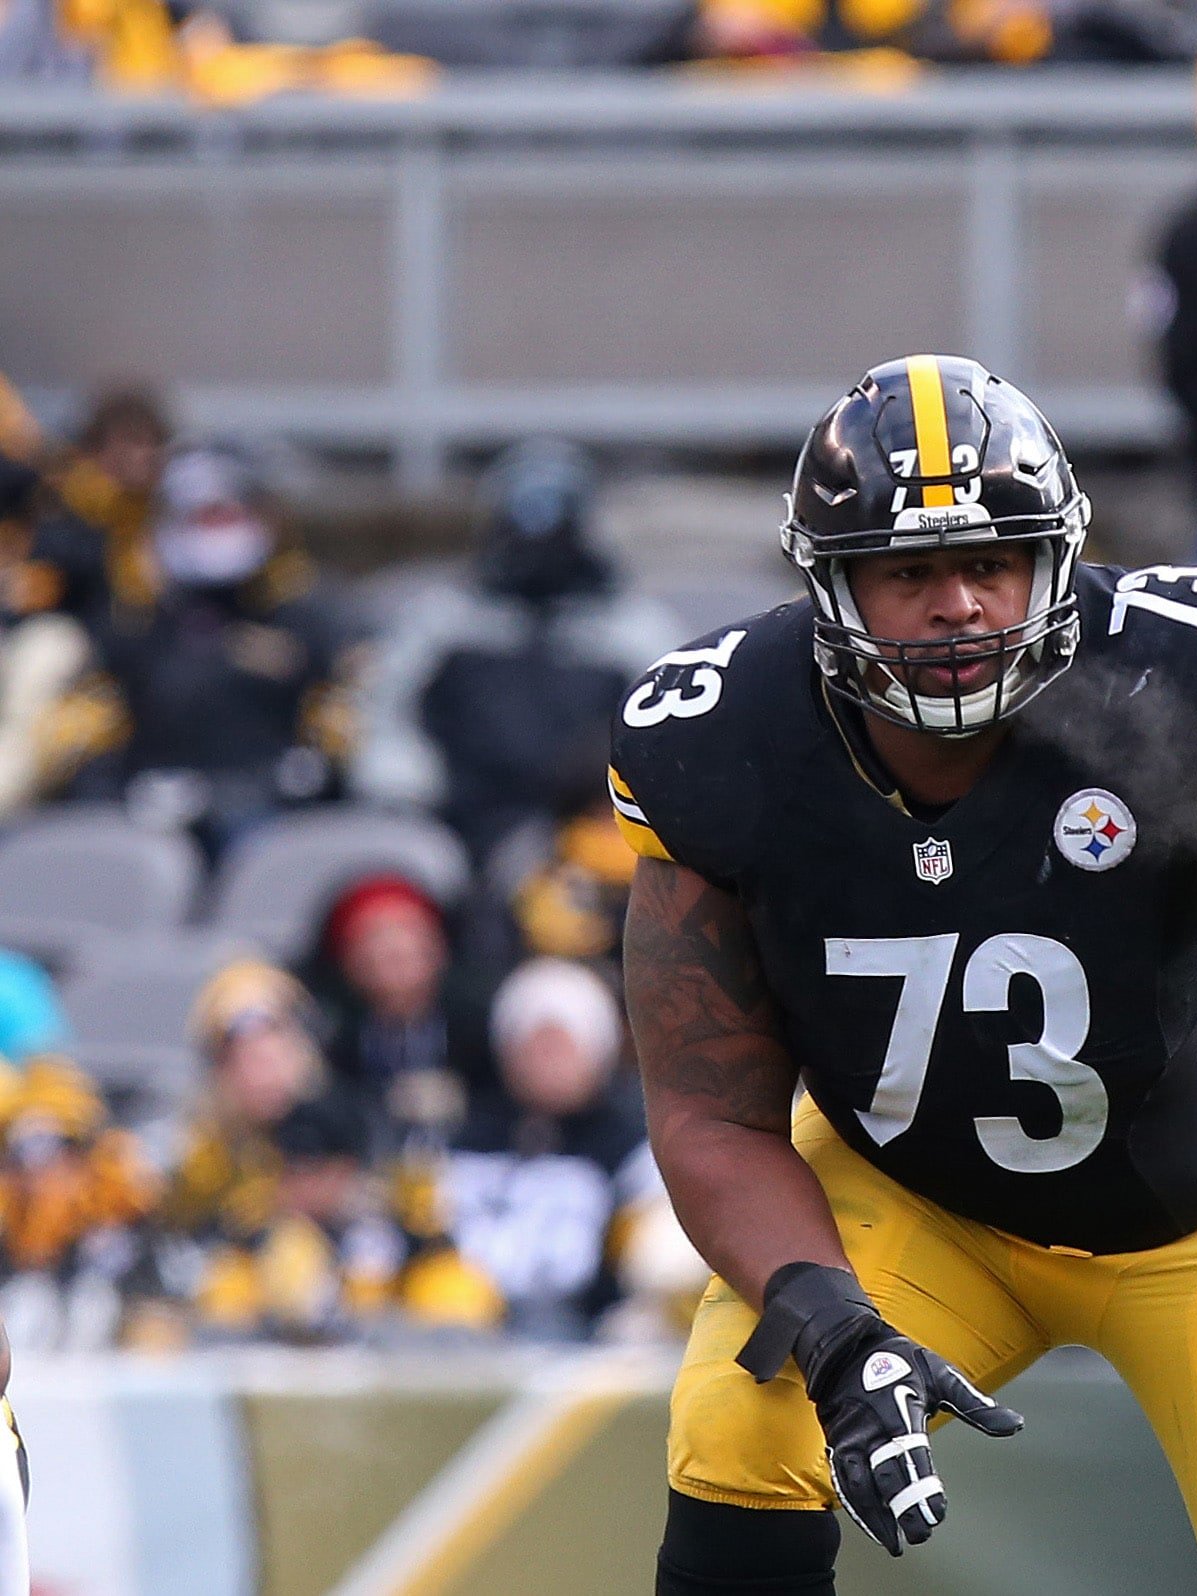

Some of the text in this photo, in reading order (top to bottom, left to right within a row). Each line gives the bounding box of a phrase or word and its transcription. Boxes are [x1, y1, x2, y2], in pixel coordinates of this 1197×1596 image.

[889, 443, 982, 513] 73
[918, 512, 969, 529] Steelers
[623, 630, 748, 728] 73
[921, 857, 949, 877] NFL
[824, 932, 1109, 1174] 73
